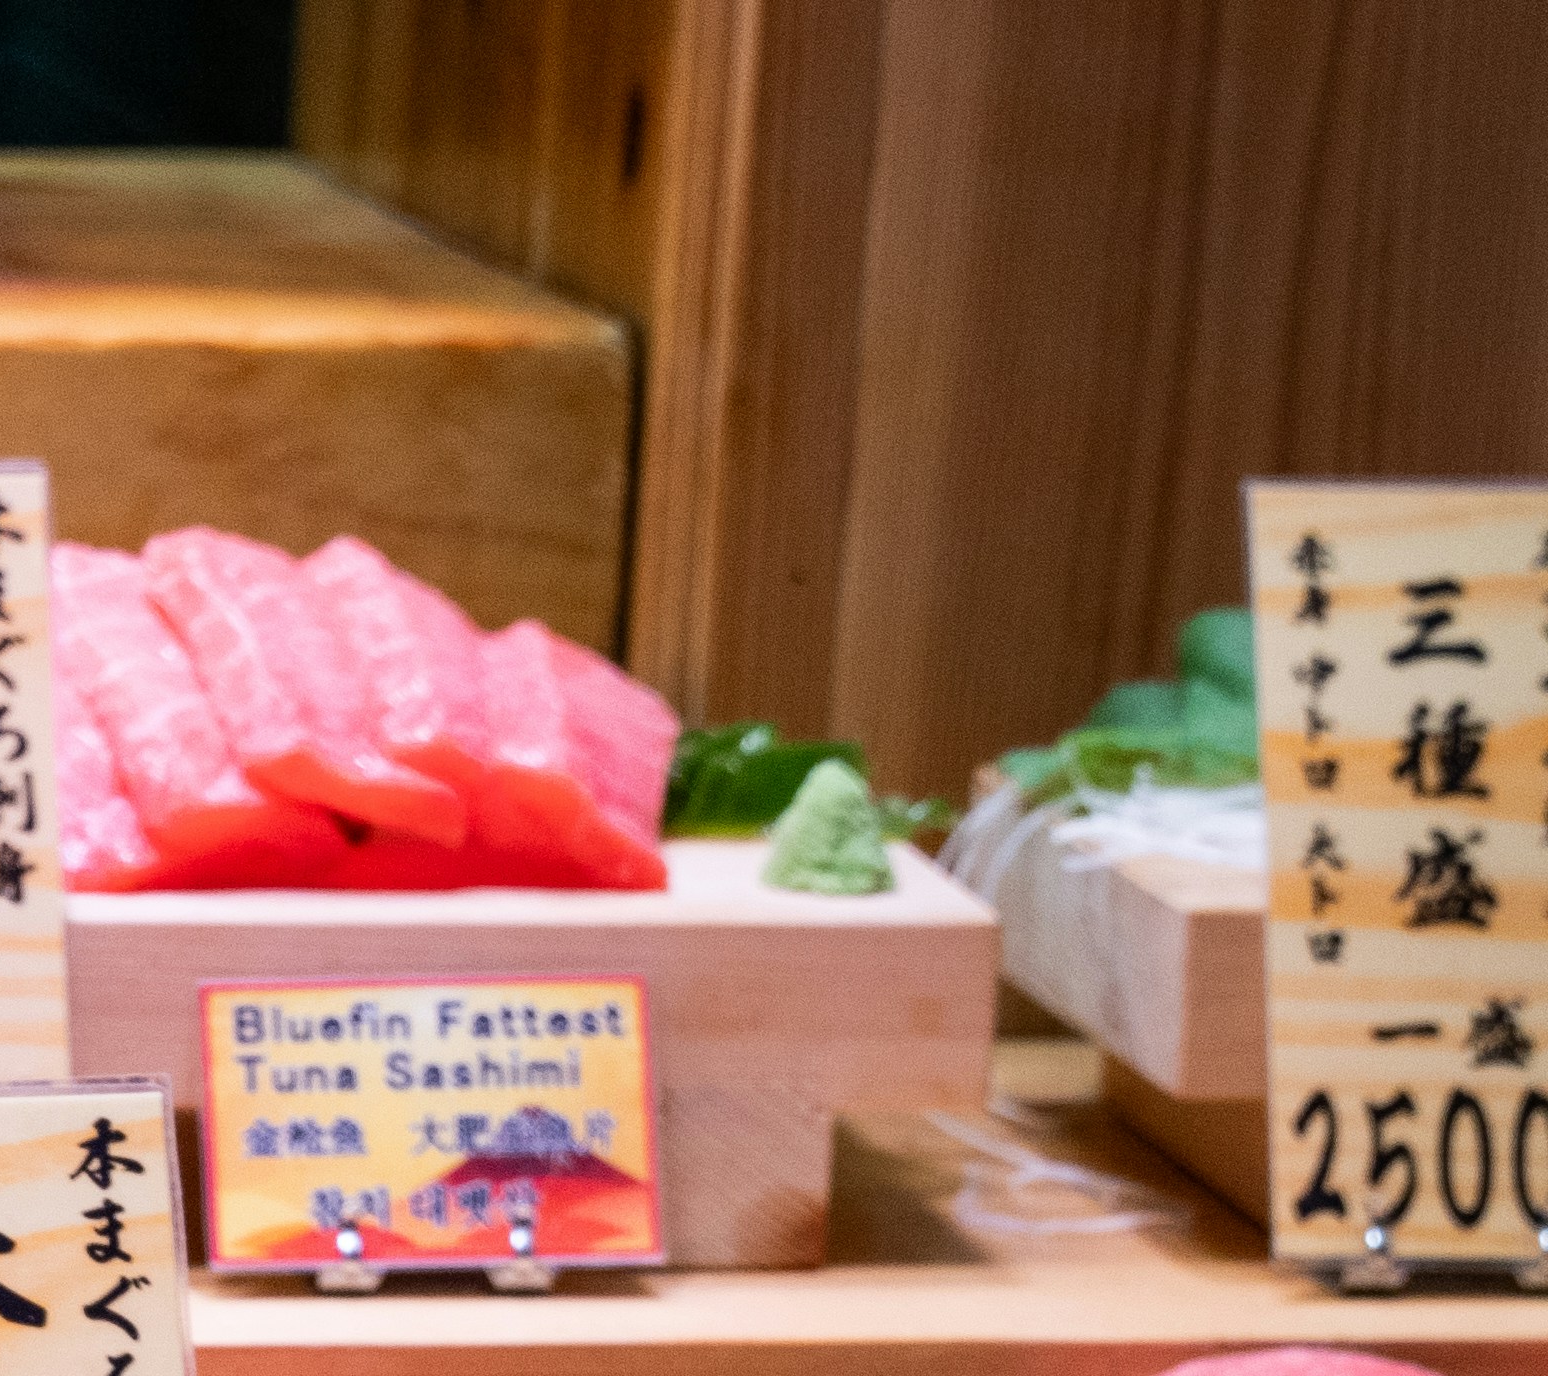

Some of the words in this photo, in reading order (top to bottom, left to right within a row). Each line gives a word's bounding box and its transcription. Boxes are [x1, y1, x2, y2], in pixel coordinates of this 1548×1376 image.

[1387, 577, 1498, 930] 三種盛
[234, 1003, 410, 1043] Bluefin
[436, 1000, 623, 1039] Fattest
[236, 1054, 356, 1092] Tuna
[386, 1050, 581, 1090] Sashimi
